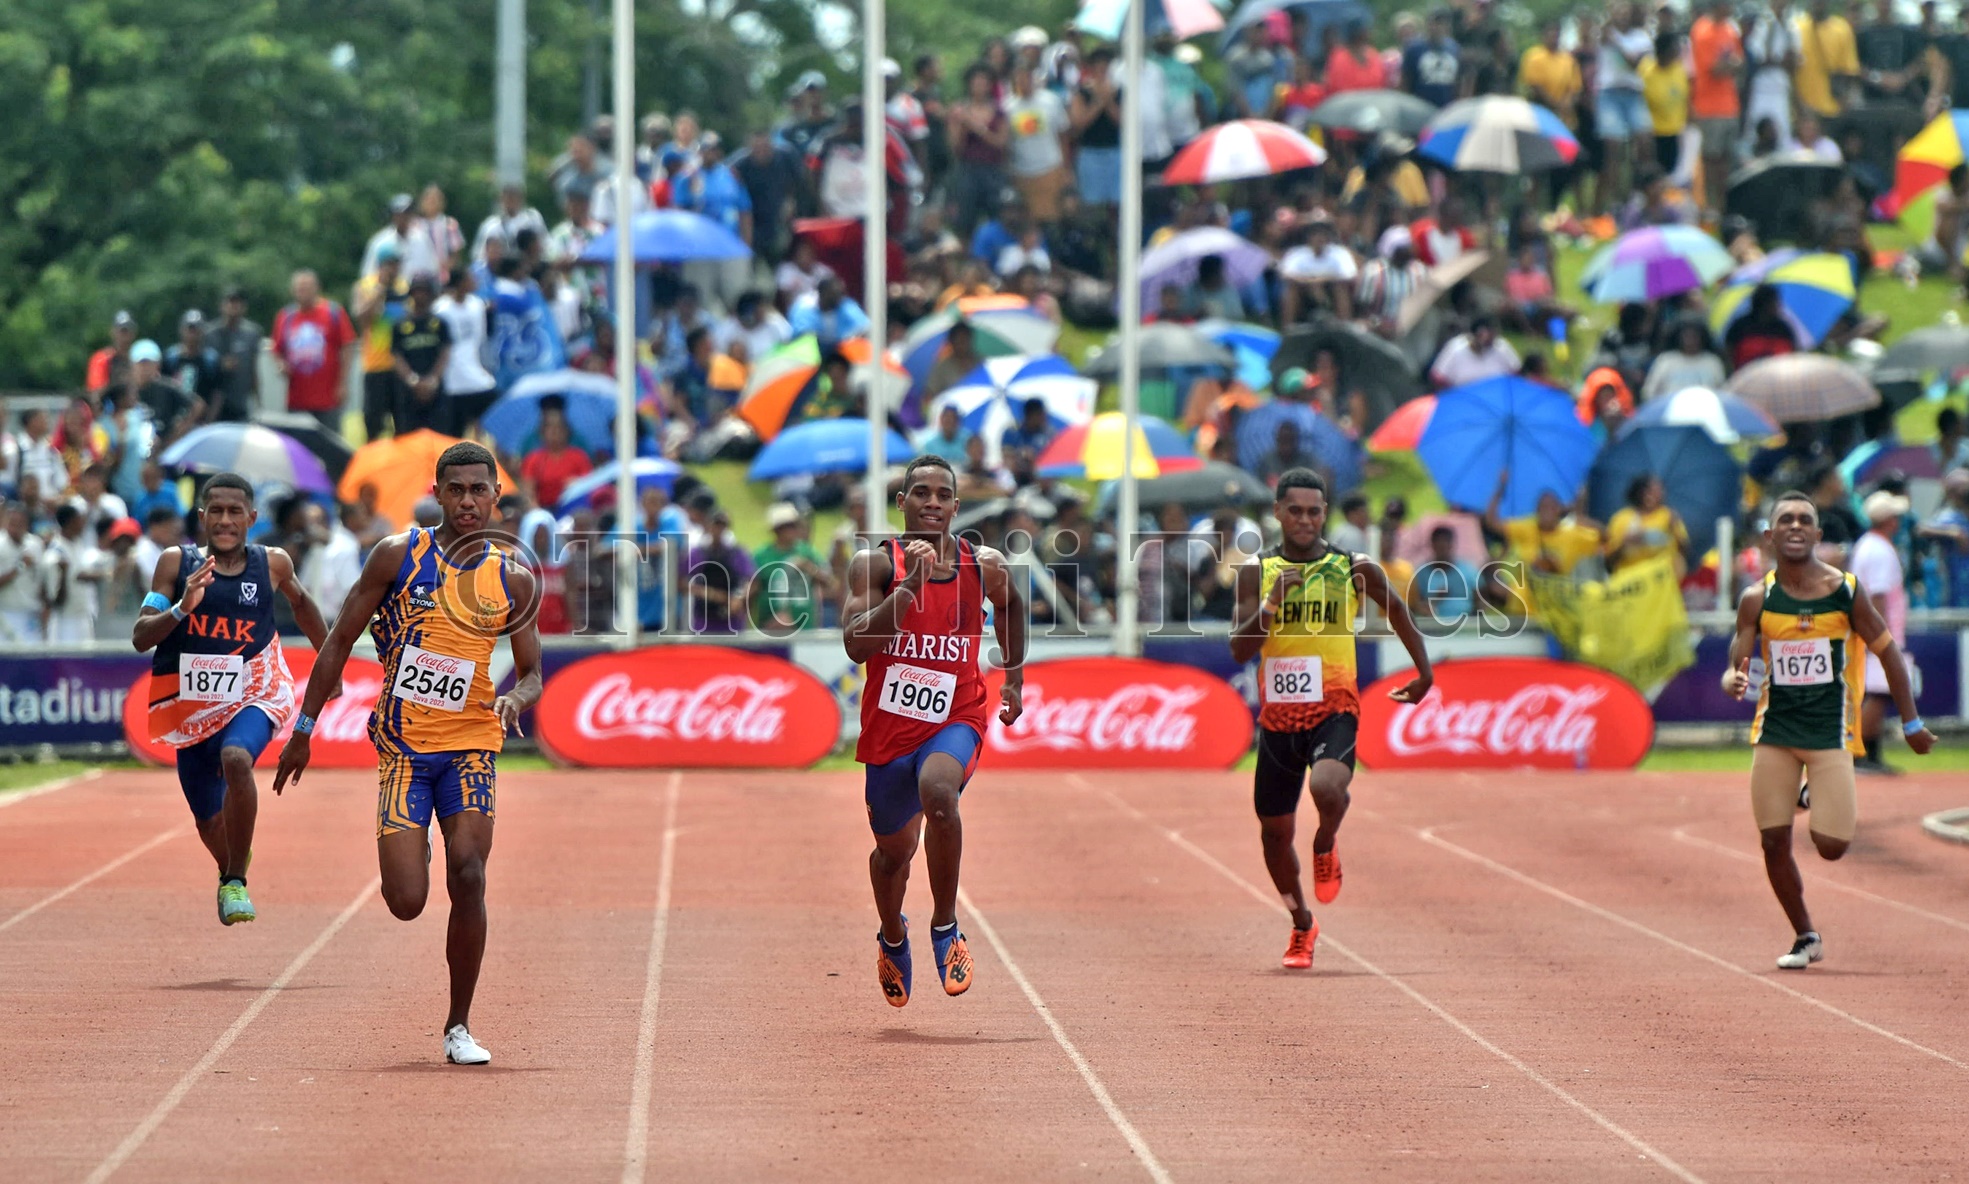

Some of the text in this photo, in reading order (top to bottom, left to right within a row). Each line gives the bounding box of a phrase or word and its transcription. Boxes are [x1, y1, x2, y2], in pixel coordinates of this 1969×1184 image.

[409, 597, 436, 608] BEYOND
[1275, 600, 1338, 624] CENTRAL
[187, 613, 256, 642] NAK
[882, 632, 970, 662] MARIST
[1776, 654, 1827, 676] 1673
[184, 671, 239, 693] 1877
[400, 665, 466, 701] 2546
[1274, 672, 1312, 694] 882
[0, 677, 128, 725] tadiu
[413, 693, 445, 707] Suva 2023
[889, 681, 948, 714] 1906
[898, 707, 929, 719] Suva 2023
